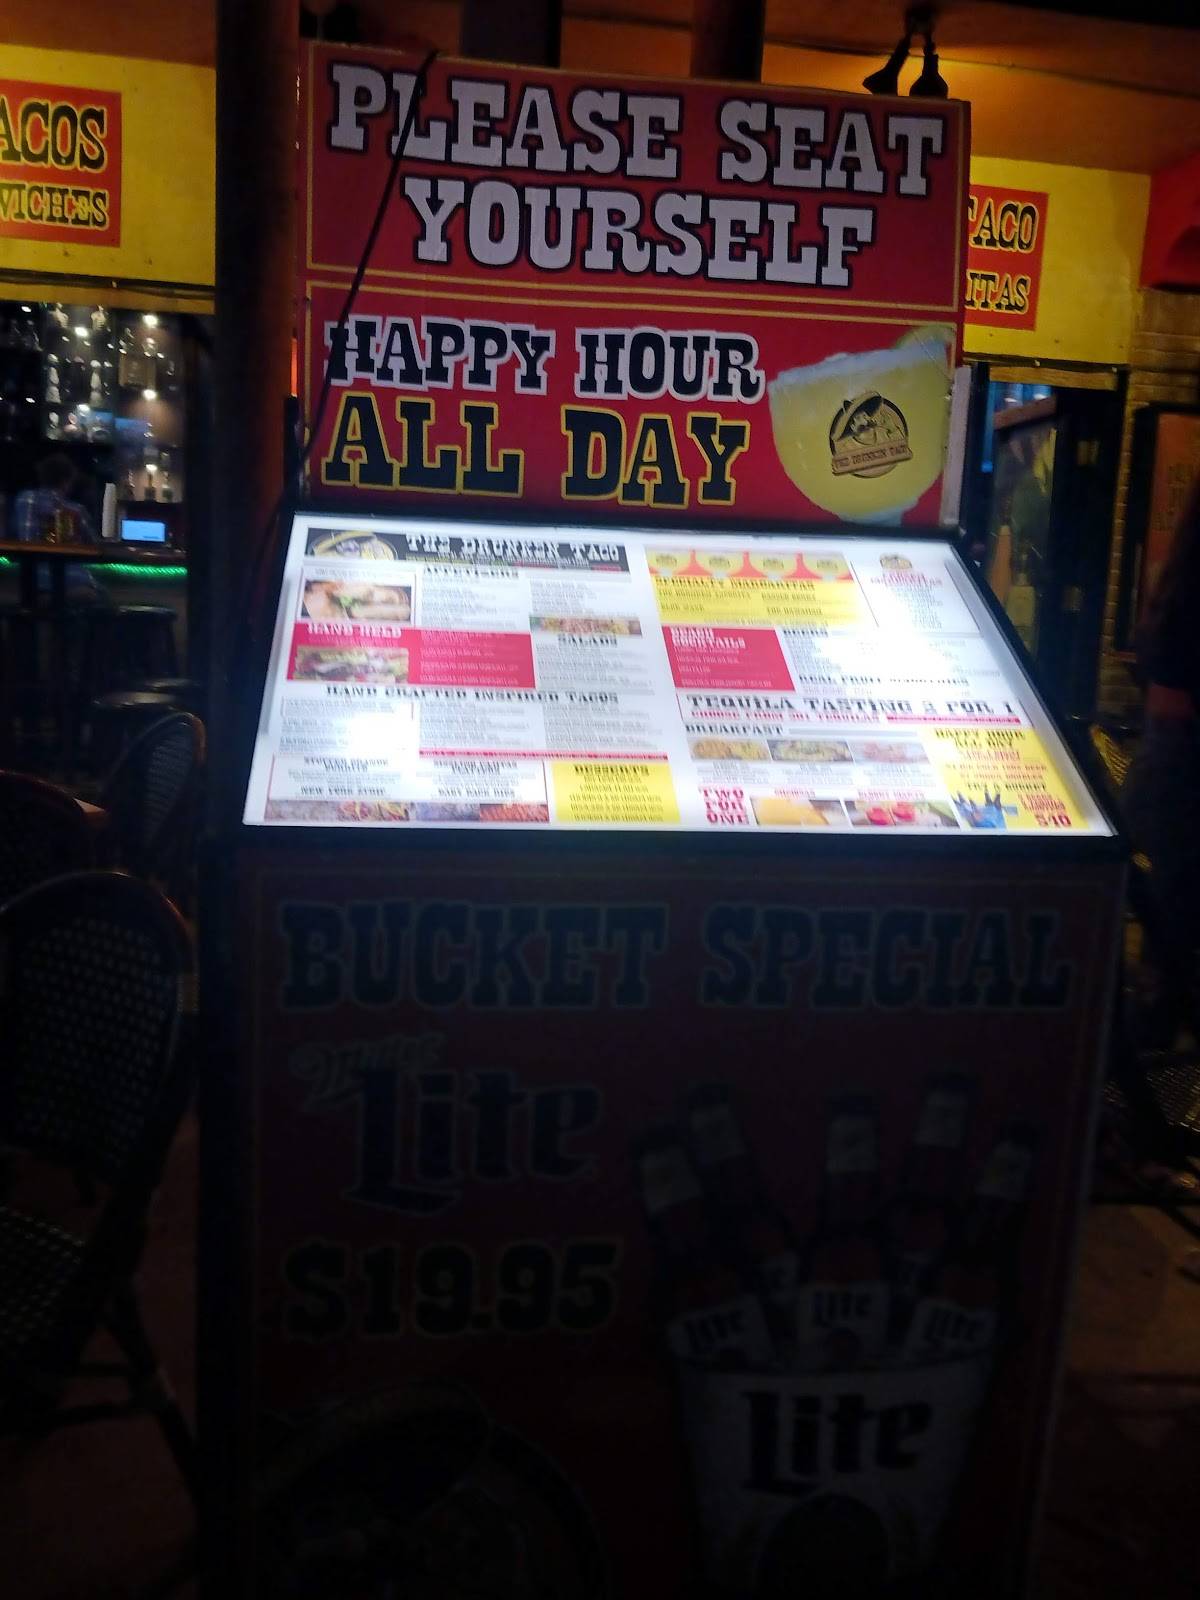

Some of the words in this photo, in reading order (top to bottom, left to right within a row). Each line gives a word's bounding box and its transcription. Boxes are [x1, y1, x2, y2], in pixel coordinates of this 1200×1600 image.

[330, 62, 681, 180] PLEASE
[719, 99, 945, 197] SEAT
[403, 175, 875, 288] YOURSELF
[966, 196, 1039, 253] ACO
[324, 313, 557, 397] HAPPY
[574, 326, 766, 404] HOUR
[321, 391, 525, 498] ALL
[560, 404, 750, 510] DAY
[406, 534, 450, 551] THE
[460, 537, 560, 559] DRUNKEN
[569, 543, 621, 562] TACO
[730, 578, 816, 591] MARGARITAS
[358, 624, 402, 638] HELD
[558, 633, 618, 647] SALADS
[326, 684, 379, 698] HAND
[383, 686, 468, 701] CRAFTED
[473, 688, 560, 703] INSPIRED
[565, 691, 620, 705] TACOS
[686, 694, 796, 711] TEQUILA
[802, 697, 914, 714] TASTING
[945, 701, 996, 715] FOR
[684, 724, 785, 737] BREAKFAST
[572, 764, 650, 776] DESSERTS
[701, 787, 745, 799] TWO
[704, 799, 747, 811] FOR
[706, 811, 750, 824] ONE
[279, 898, 671, 1011] BUCKET
[697, 900, 1077, 1013] SPECIAL
[340, 1065, 605, 1216] Lite
[282, 1232, 625, 1344] $19.95
[740, 1391, 934, 1496] Lite
